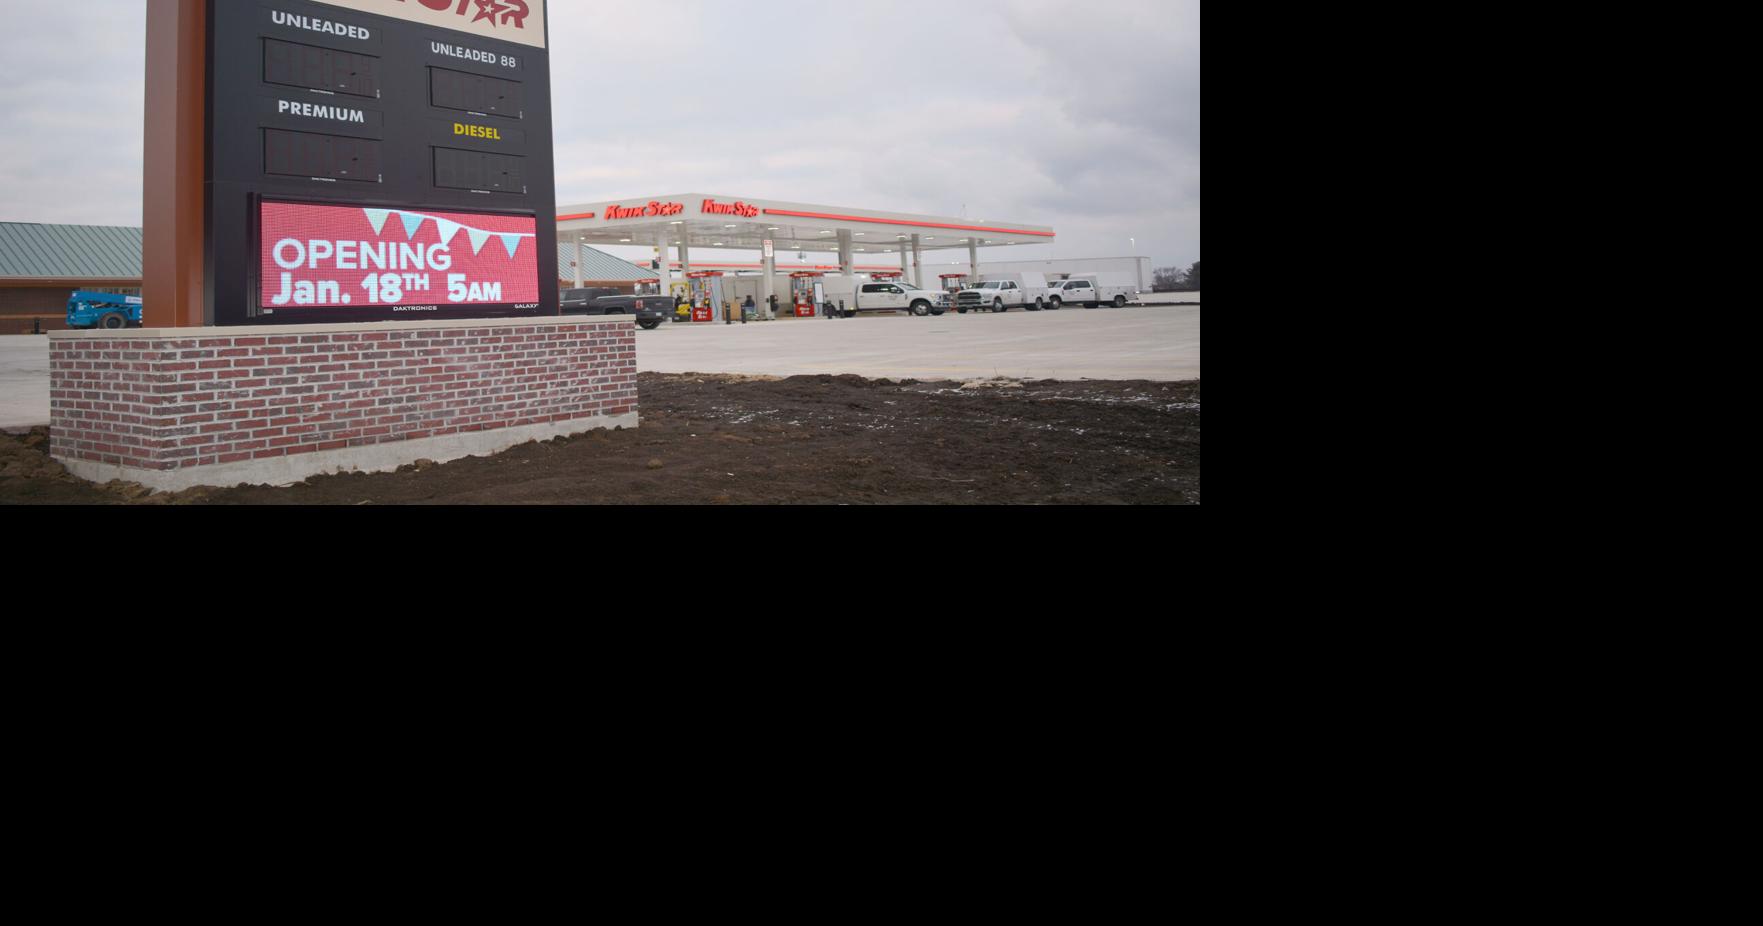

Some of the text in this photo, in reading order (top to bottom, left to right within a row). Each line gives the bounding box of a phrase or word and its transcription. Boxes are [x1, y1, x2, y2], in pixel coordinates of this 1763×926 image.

[271, 10, 370, 41] UNLEADED
[431, 41, 516, 68] UNLEADED 88
[277, 100, 365, 124] PREMIUM
[453, 123, 501, 140] DIESEL
[272, 237, 452, 271] OPENING
[271, 272, 351, 305] Jan.
[447, 273, 502, 302] 5AM
